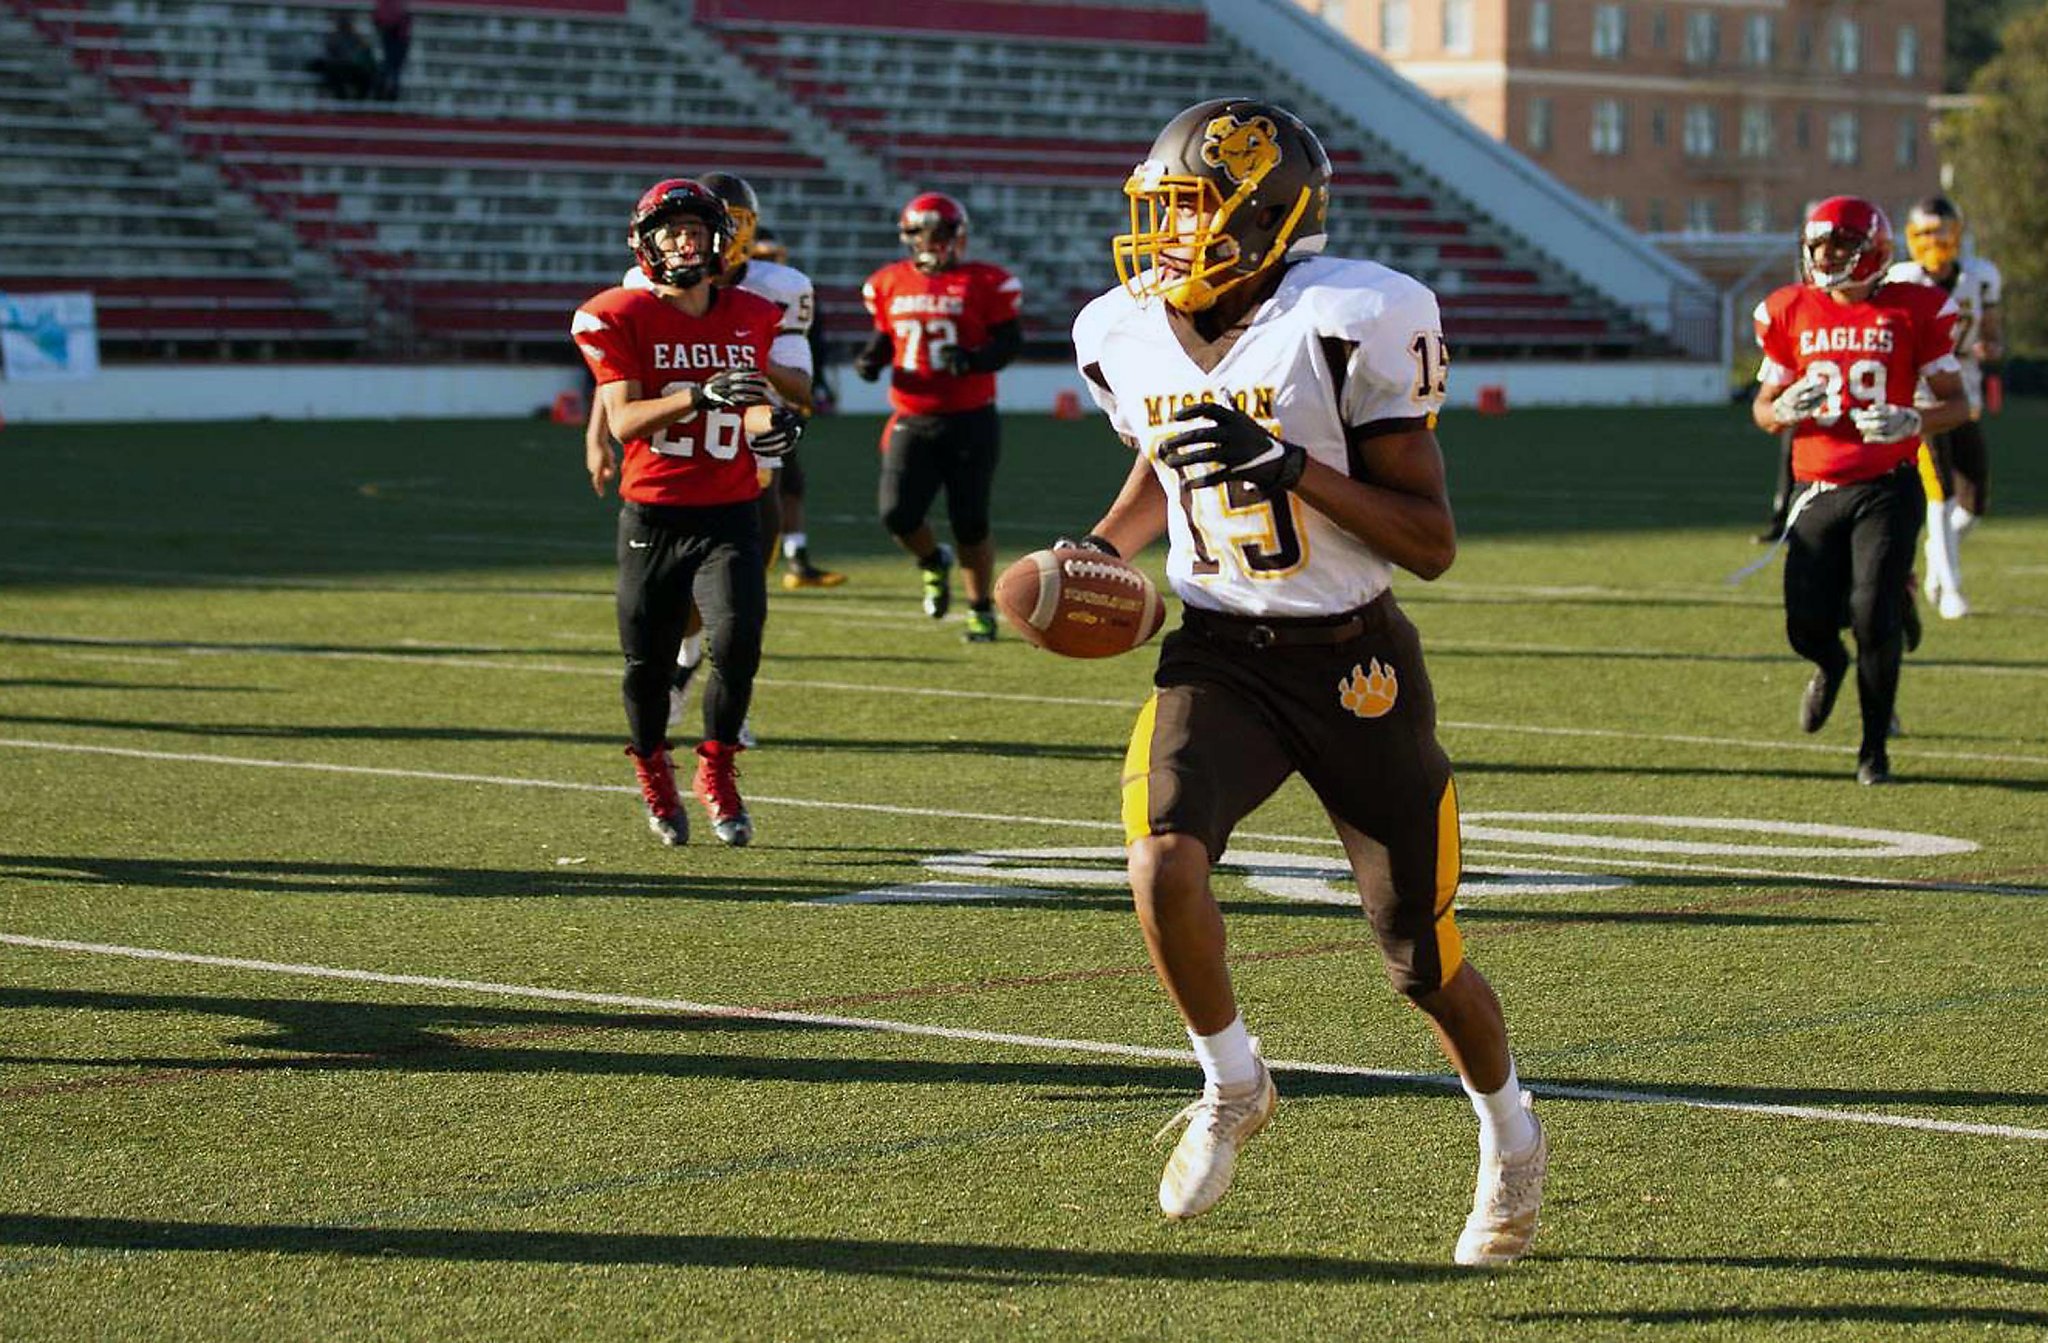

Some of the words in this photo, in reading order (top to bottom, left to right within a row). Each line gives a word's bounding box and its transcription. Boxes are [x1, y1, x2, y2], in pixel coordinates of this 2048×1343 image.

[653, 342, 756, 370] EAGLES
[893, 319, 957, 371] 72
[1800, 327, 1894, 356] EAGLES
[650, 380, 743, 460] 26
[1144, 386, 1274, 427] MION
[1152, 426, 1310, 581] 15
